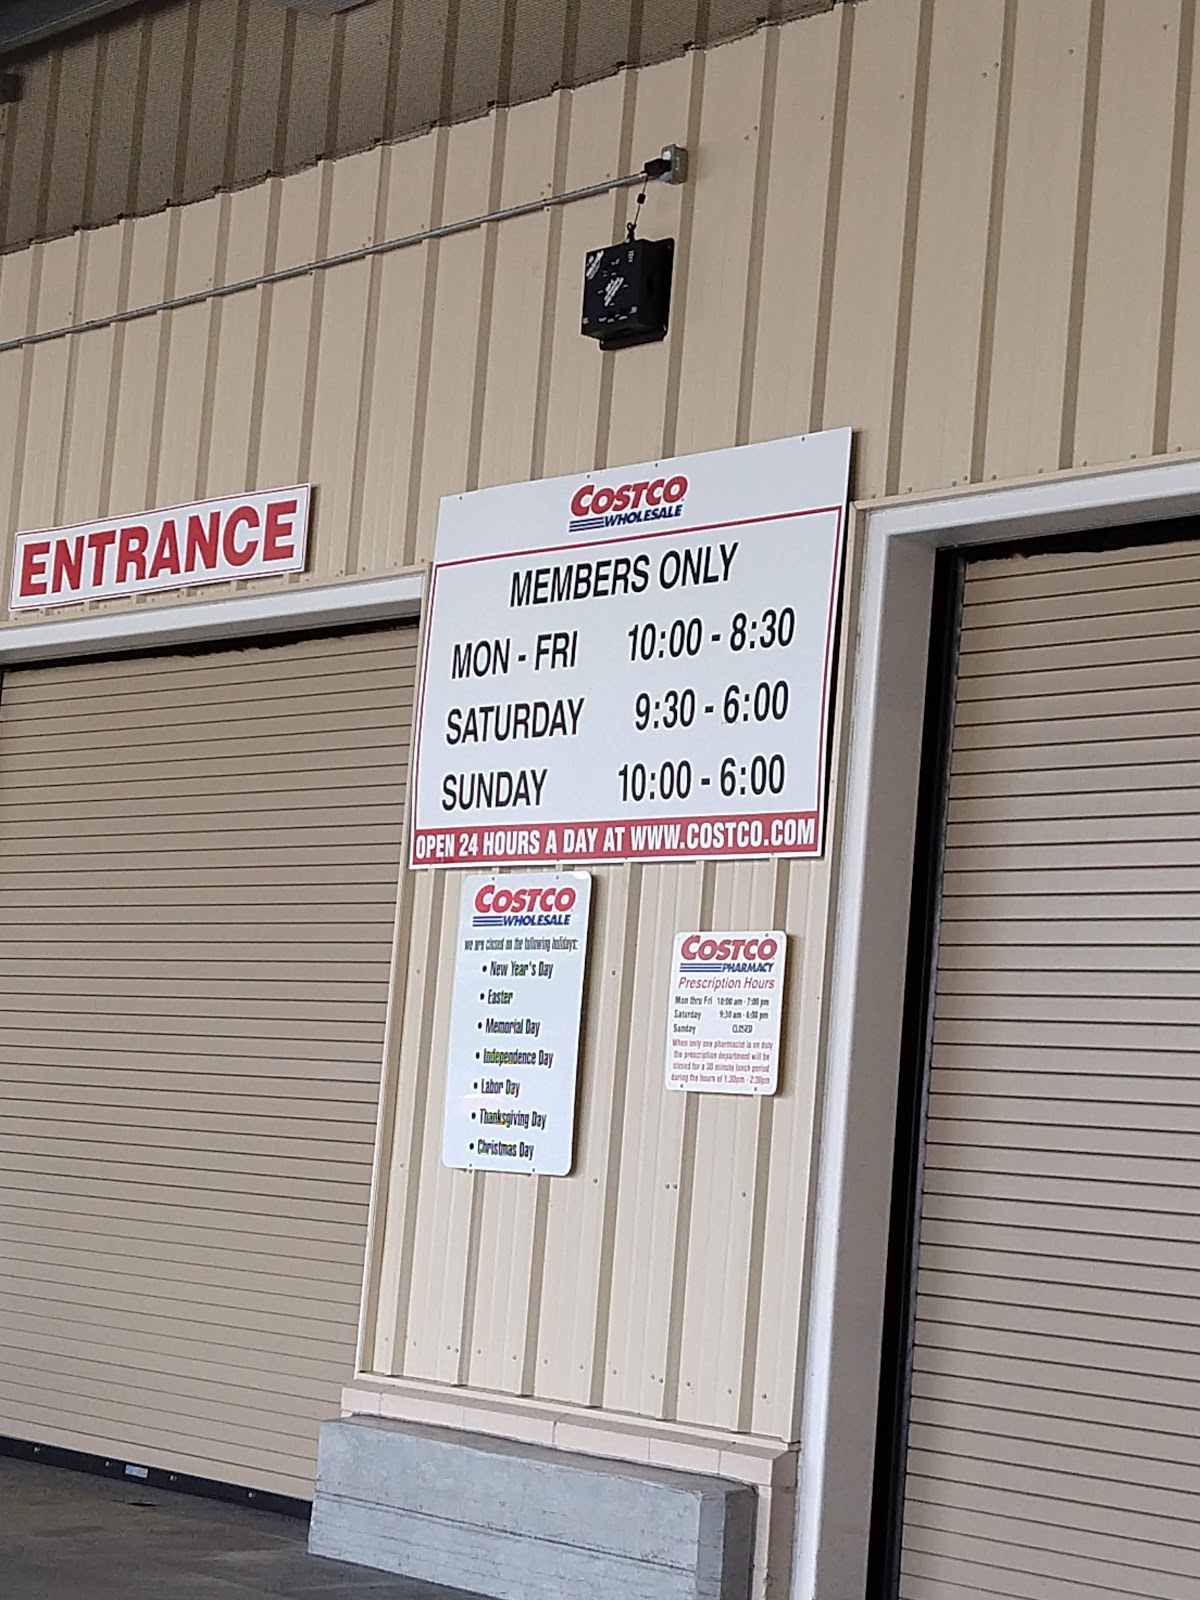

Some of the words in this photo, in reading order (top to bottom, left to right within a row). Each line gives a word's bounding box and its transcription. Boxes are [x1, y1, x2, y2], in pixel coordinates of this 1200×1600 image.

[571, 475, 688, 517] COSTCO
[604, 504, 682, 528] WHOLESALE
[20, 500, 297, 597] ENTRANCE
[509, 554, 649, 607] MEMBERS
[659, 542, 739, 589] ONLY
[452, 639, 510, 679] MON
[534, 631, 578, 670] FRI
[628, 619, 702, 661] 10:00
[730, 607, 795, 651] 8:30
[446, 698, 584, 745] SATURDAY
[635, 689, 695, 730] 9:30
[723, 680, 788, 724] 6:00
[442, 769, 547, 810] SUNDAY
[618, 760, 691, 802] 10:00
[720, 754, 785, 796] 6:00
[415, 834, 455, 859] OPEN
[459, 834, 478, 856] 24
[482, 831, 539, 855] HOURS
[545, 830, 557, 852] A
[563, 828, 598, 853] DAY
[603, 827, 626, 851] AT
[629, 818, 815, 850] WWW.COSTCO.COM
[475, 885, 576, 913] COSTCO
[502, 915, 571, 926] WHOLESALE
[475, 940, 484, 950] are
[486, 938, 504, 950] closed
[514, 938, 523, 950] the
[525, 937, 550, 952] following
[681, 935, 777, 960] COSTCO
[490, 961, 507, 976] New
[511, 961, 536, 976] Year's
[539, 962, 553, 978] Day
[722, 963, 774, 972] PHARMACY
[679, 977, 741, 991] Prescription
[743, 978, 775, 988] Hours
[488, 989, 513, 1004] Easter
[690, 996, 702, 1005] thru
[704, 997, 713, 1005] Fri
[717, 997, 732, 1005] 10:00
[760, 999, 769, 1007] pm
[674, 1010, 701, 1020] Saturday
[719, 1011, 731, 1019] 9:30
[759, 1012, 768, 1020] pm
[486, 1018, 523, 1034] Memorial
[526, 1019, 540, 1037] Day
[673, 1024, 696, 1034] Sunday
[673, 1039, 688, 1047] When
[715, 1040, 745, 1049] pharmacist
[761, 1041, 773, 1050] duty
[483, 1049, 536, 1066] Independence
[539, 1050, 553, 1068] Day
[684, 1051, 716, 1060] prescription
[719, 1051, 750, 1060] department
[752, 1052, 762, 1060] will
[673, 1062, 690, 1070] closed
[692, 1062, 700, 1070] for
[715, 1063, 734, 1071] minute
[736, 1063, 750, 1072] lunch
[752, 1065, 769, 1073] period
[671, 1074, 688, 1082] during
[690, 1074, 698, 1082] the
[700, 1074, 715, 1082] hours
[482, 1079, 503, 1094] Labor
[506, 1079, 520, 1097] Day
[480, 1109, 529, 1129] Thanksgiving
[532, 1111, 547, 1129] Day
[478, 1139, 516, 1156] Christmas
[519, 1142, 534, 1160] Day
